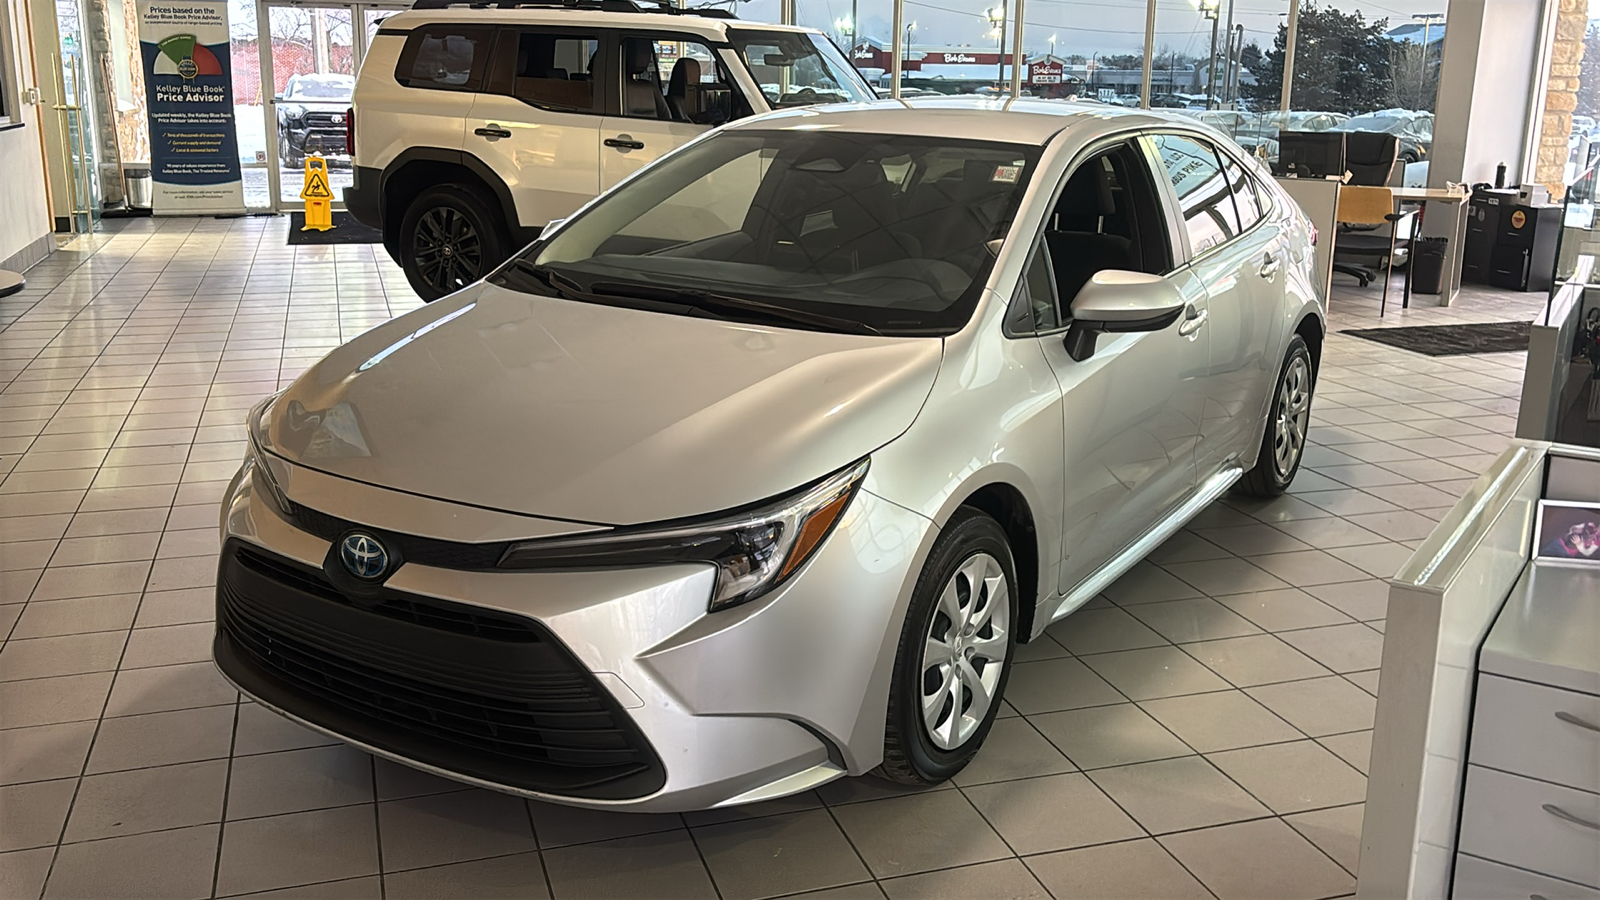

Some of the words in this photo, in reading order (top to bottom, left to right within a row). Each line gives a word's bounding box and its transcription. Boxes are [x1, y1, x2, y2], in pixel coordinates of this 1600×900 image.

[943, 54, 958, 63] Bob
[957, 53, 976, 63] Evans
[1033, 65, 1045, 75] Bob
[1044, 65, 1061, 74] Evans
[156, 85, 181, 93] Kelley
[182, 85, 202, 93] Blue
[157, 93, 184, 102] Price
[186, 93, 224, 102] Advisor
